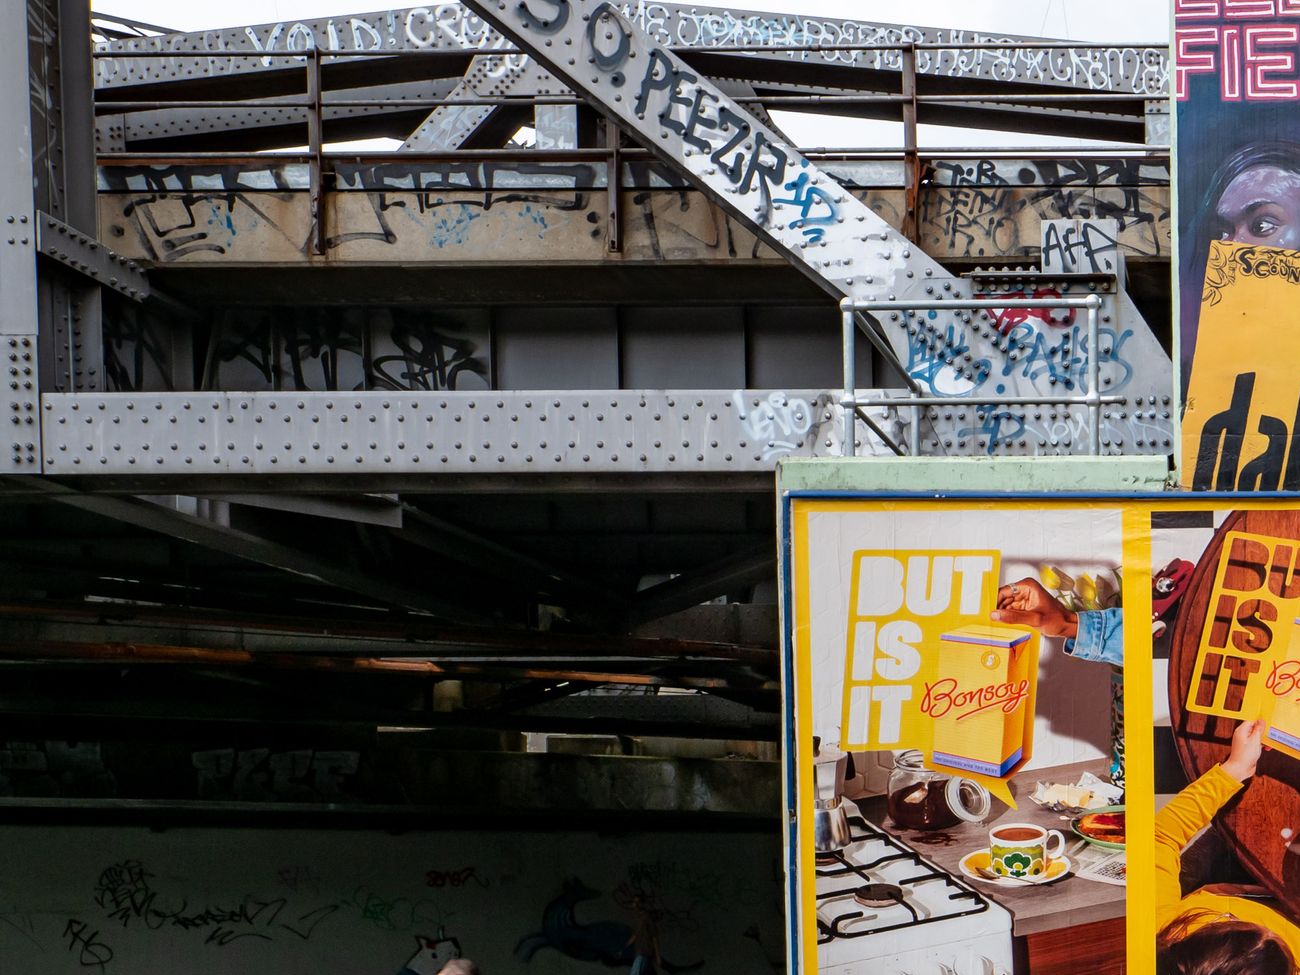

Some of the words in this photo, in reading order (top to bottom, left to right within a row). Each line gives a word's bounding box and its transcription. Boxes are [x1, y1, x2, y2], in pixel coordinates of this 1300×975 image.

[856, 555, 993, 616] BUT
[852, 620, 923, 681] IS
[1208, 594, 1278, 654] IS
[920, 677, 1030, 721] Bonsoy
[1194, 652, 1261, 712] IT
[847, 685, 913, 744] IT
